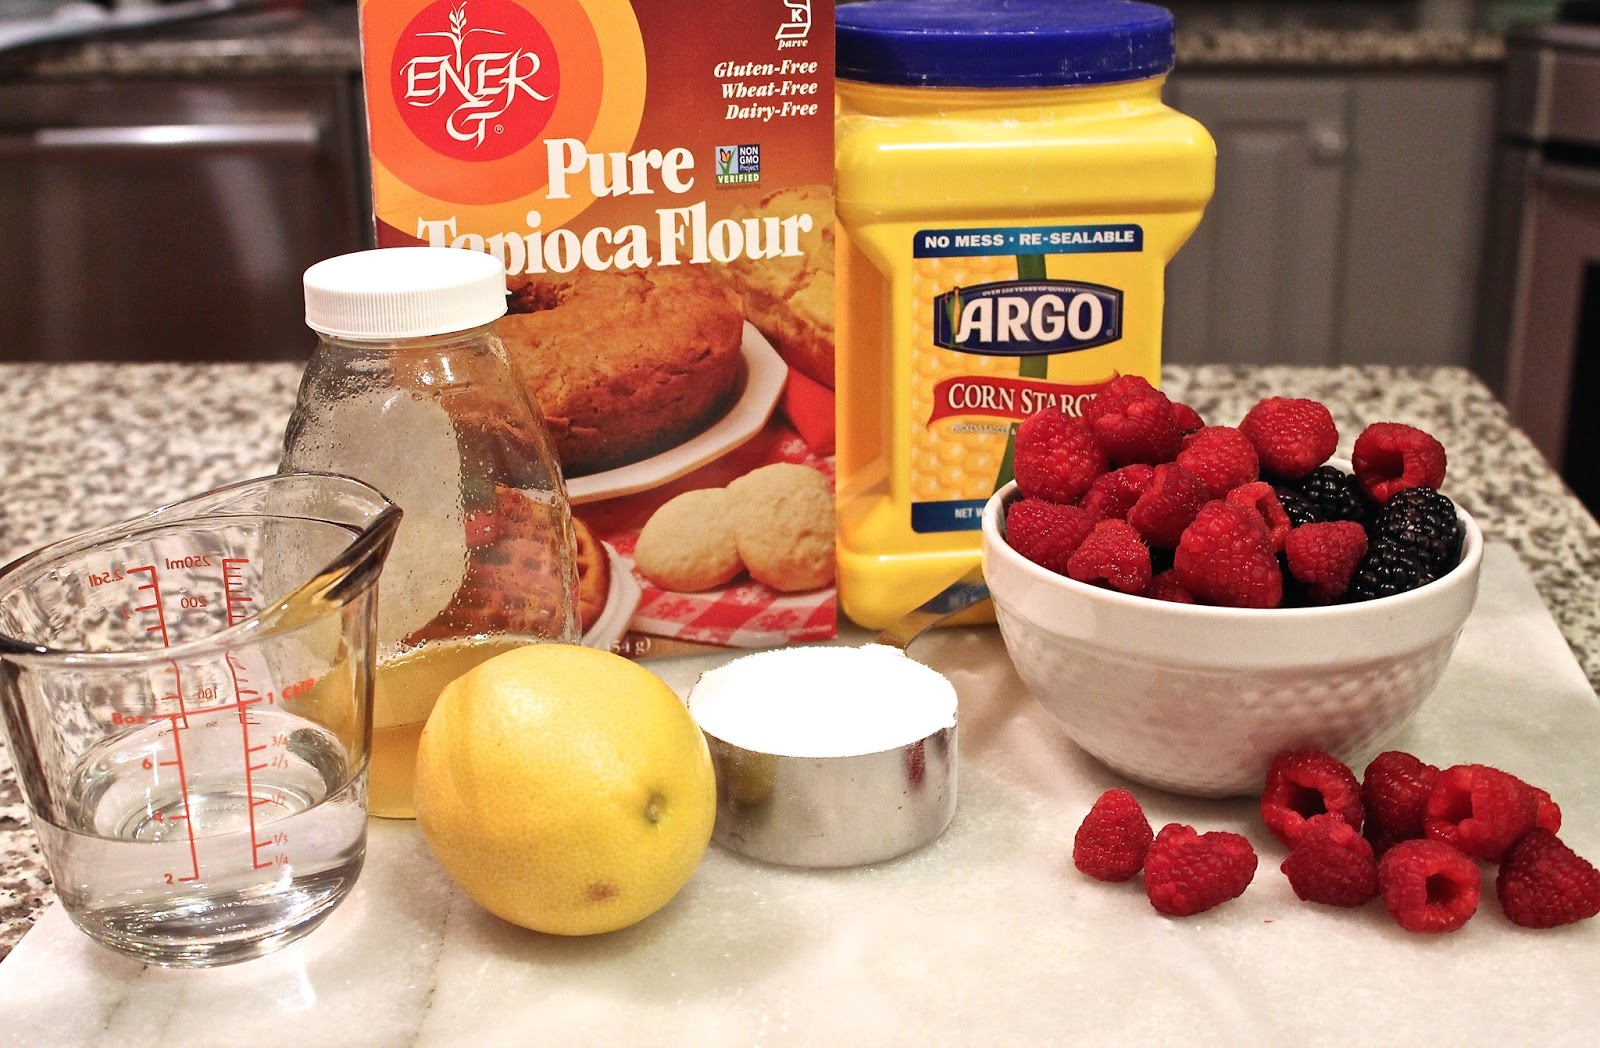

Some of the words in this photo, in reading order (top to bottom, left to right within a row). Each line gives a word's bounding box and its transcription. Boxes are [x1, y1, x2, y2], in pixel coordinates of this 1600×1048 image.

[777, 40, 808, 50] parve
[713, 59, 818, 78] Gluten-Free
[400, 47, 554, 107] ENER
[721, 80, 818, 98] Wheat-Free
[725, 101, 818, 122] Dairy-Free
[740, 146, 759, 156] NON
[740, 155, 760, 165] GMO
[543, 137, 695, 200] Pure
[740, 164, 759, 172] Project
[717, 173, 760, 184] VERIFIED
[656, 201, 813, 267] Flour
[925, 235, 950, 249] NO
[955, 233, 1005, 248] MESS
[1019, 230, 1135, 246] RE-SEALABLE
[955, 293, 1103, 343] ARGO
[949, 383, 1015, 411] CORN
[1021, 388, 1098, 418] STARC
[954, 507, 973, 519] NET
[267, 691, 275, 705] 1
[142, 758, 154, 770] 6
[271, 753, 289, 769] 2/3
[274, 831, 288, 846] 1/3
[275, 852, 289, 867] 1/4
[163, 873, 174, 885] 2
